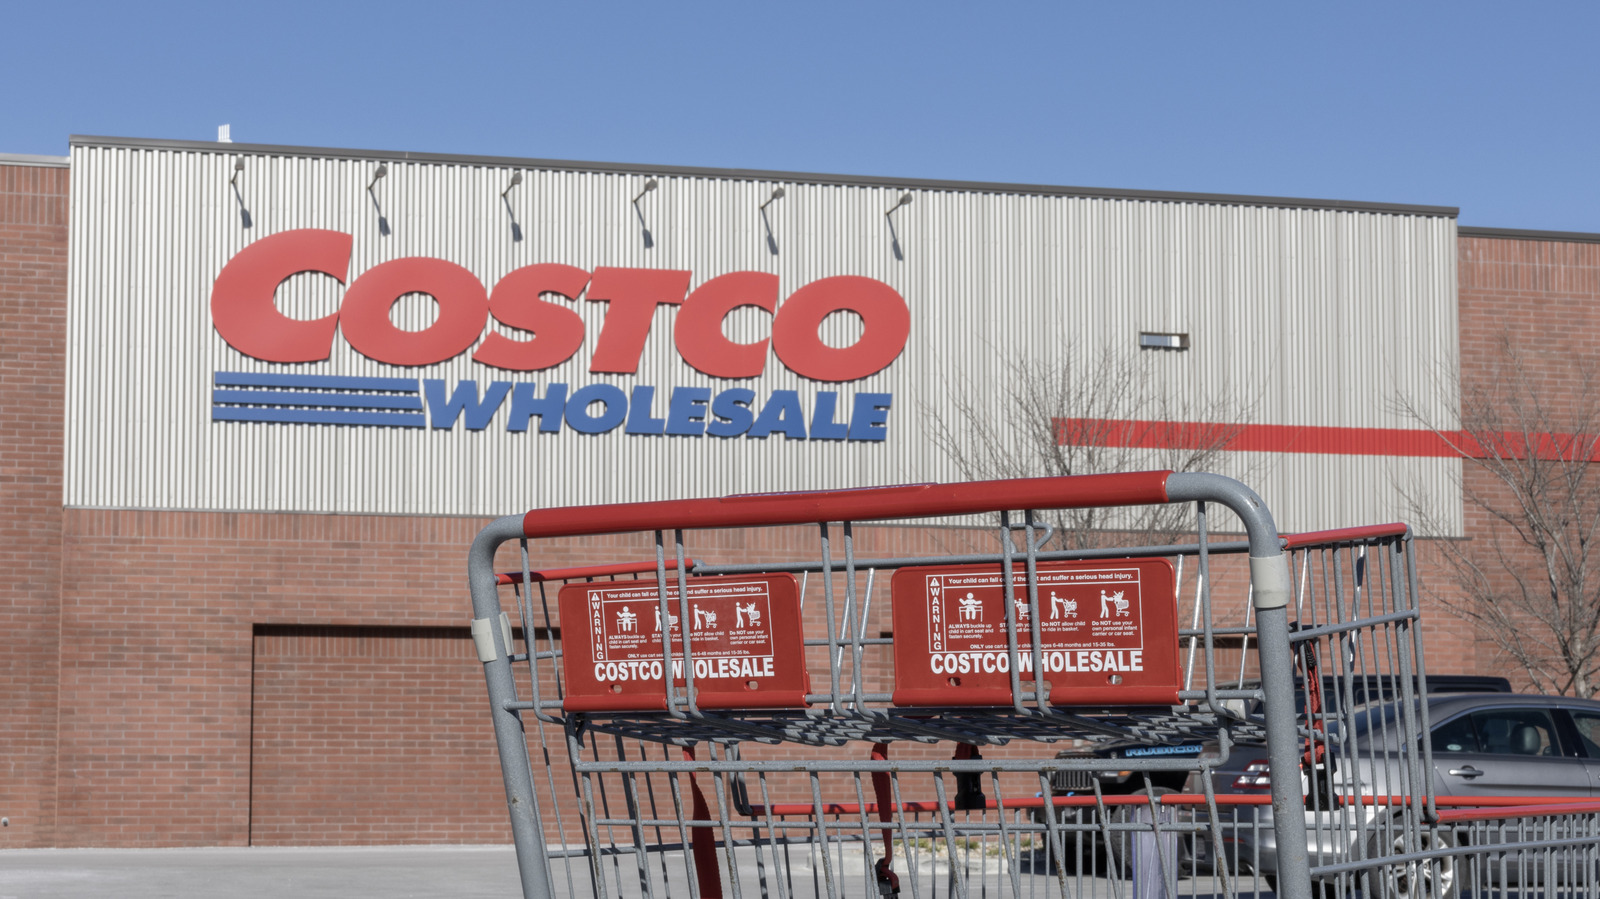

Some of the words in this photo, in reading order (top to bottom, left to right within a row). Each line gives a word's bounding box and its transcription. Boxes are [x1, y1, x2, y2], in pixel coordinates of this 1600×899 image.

[210, 228, 911, 382] COSTCO
[423, 379, 892, 442] WHOLESALE
[592, 602, 604, 660] WARNING
[930, 588, 942, 650] WARNING
[594, 661, 662, 681] COSTCO
[930, 653, 1010, 674] COSTCO
[1018, 651, 1143, 672] WHOLESALE
